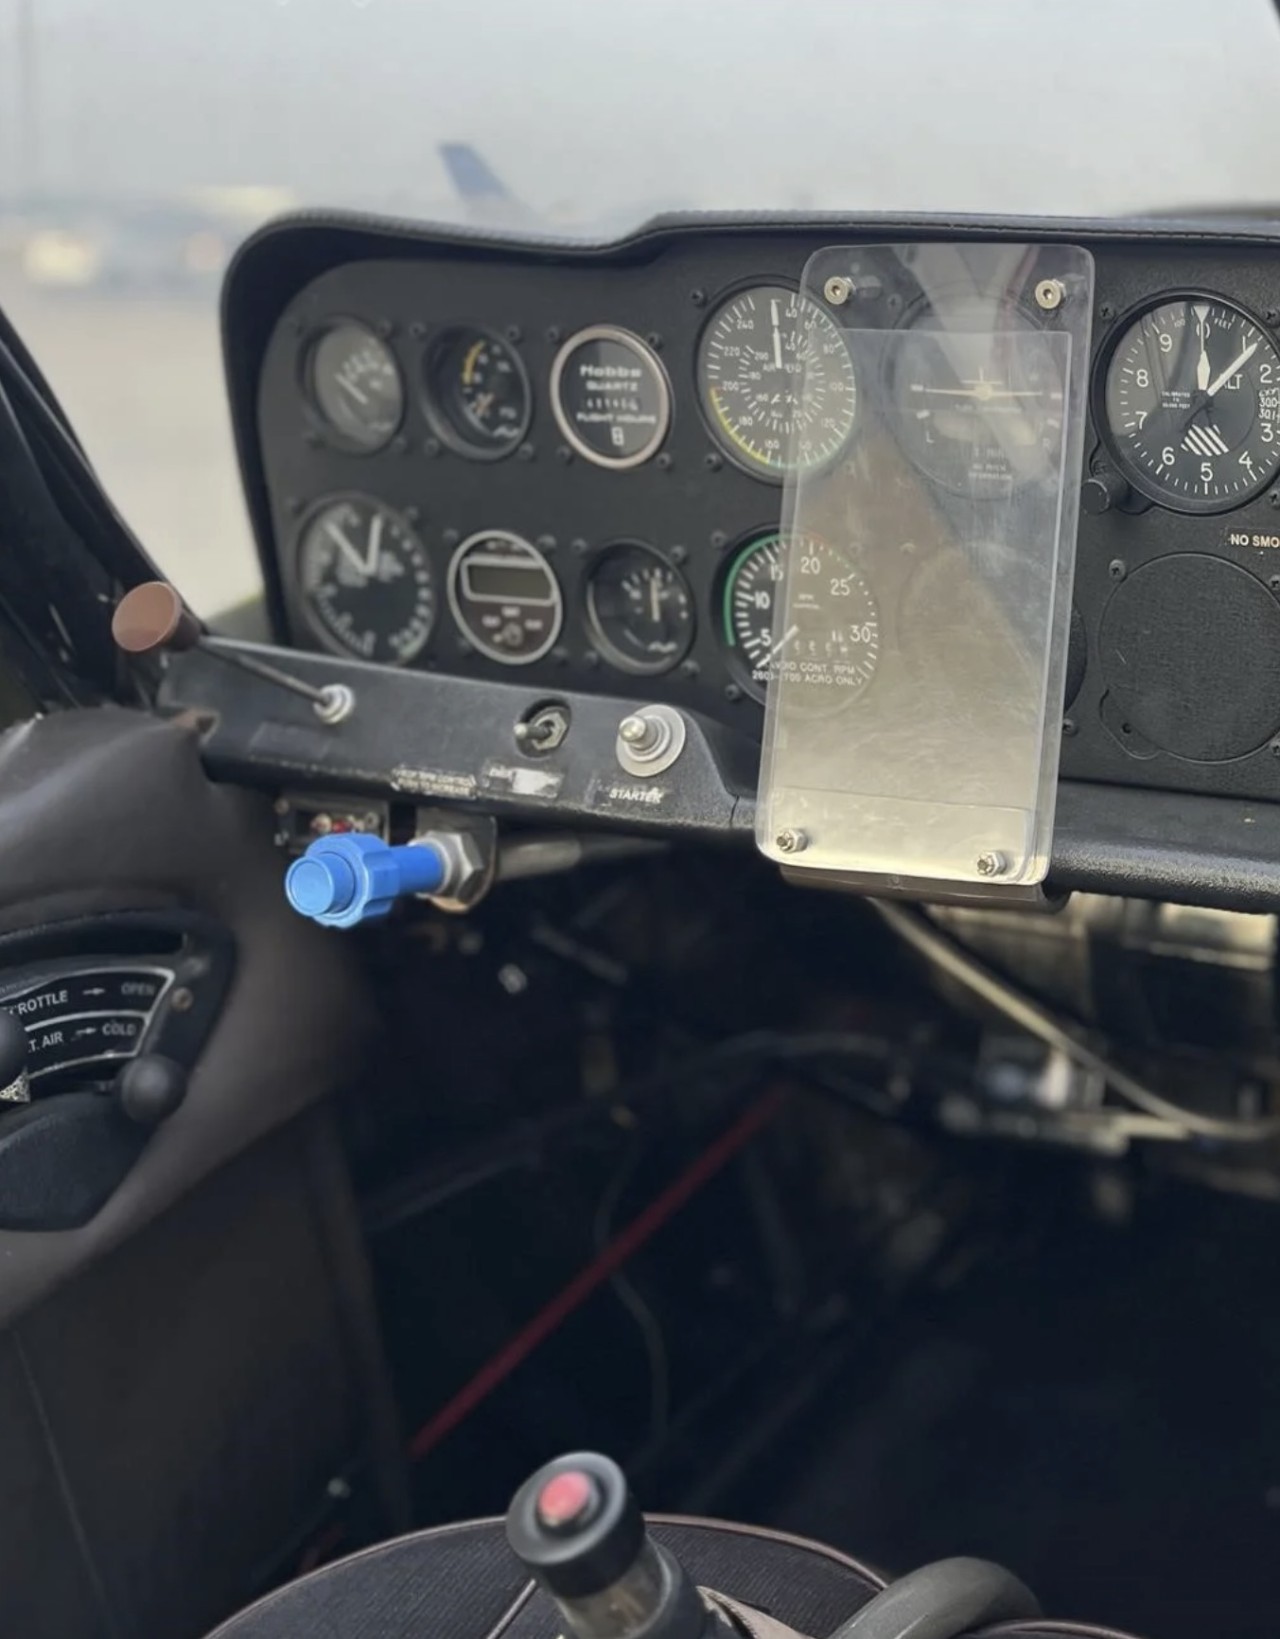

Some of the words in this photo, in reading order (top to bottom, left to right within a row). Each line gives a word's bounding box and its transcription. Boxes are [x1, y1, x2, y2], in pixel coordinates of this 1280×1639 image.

[785, 309, 798, 318] 40
[737, 320, 754, 330] 240
[804, 321, 817, 330] 60
[1214, 317, 1232, 330] FEET
[724, 346, 741, 357] 220
[1159, 334, 1173, 352] 9
[1136, 369, 1149, 388] 8
[1222, 374, 1243, 390] LT
[1259, 364, 1272, 384] 2
[722, 381, 740, 391] 200
[739, 416, 753, 426] 180
[1135, 411, 1148, 430] 7
[1260, 423, 1273, 442] 3
[1162, 447, 1175, 465] 6
[1238, 451, 1252, 469] 4
[1200, 463, 1213, 482] 5
[1231, 533, 1249, 546] NO
[770, 564, 784, 581] 15
[801, 557, 821, 575] 20
[830, 578, 850, 596] 25
[755, 591, 770, 610] 10
[760, 629, 772, 647] 5
[850, 625, 871, 643] 30
[833, 664, 856, 675] RPM
[804, 674, 833, 684] ACRO
[835, 676, 863, 686] ONLY
[3, 989, 68, 1015] ROTTLE
[121, 982, 156, 996] OPEN
[42, 1031, 63, 1048] AIR
[102, 1022, 136, 1036] COLD
